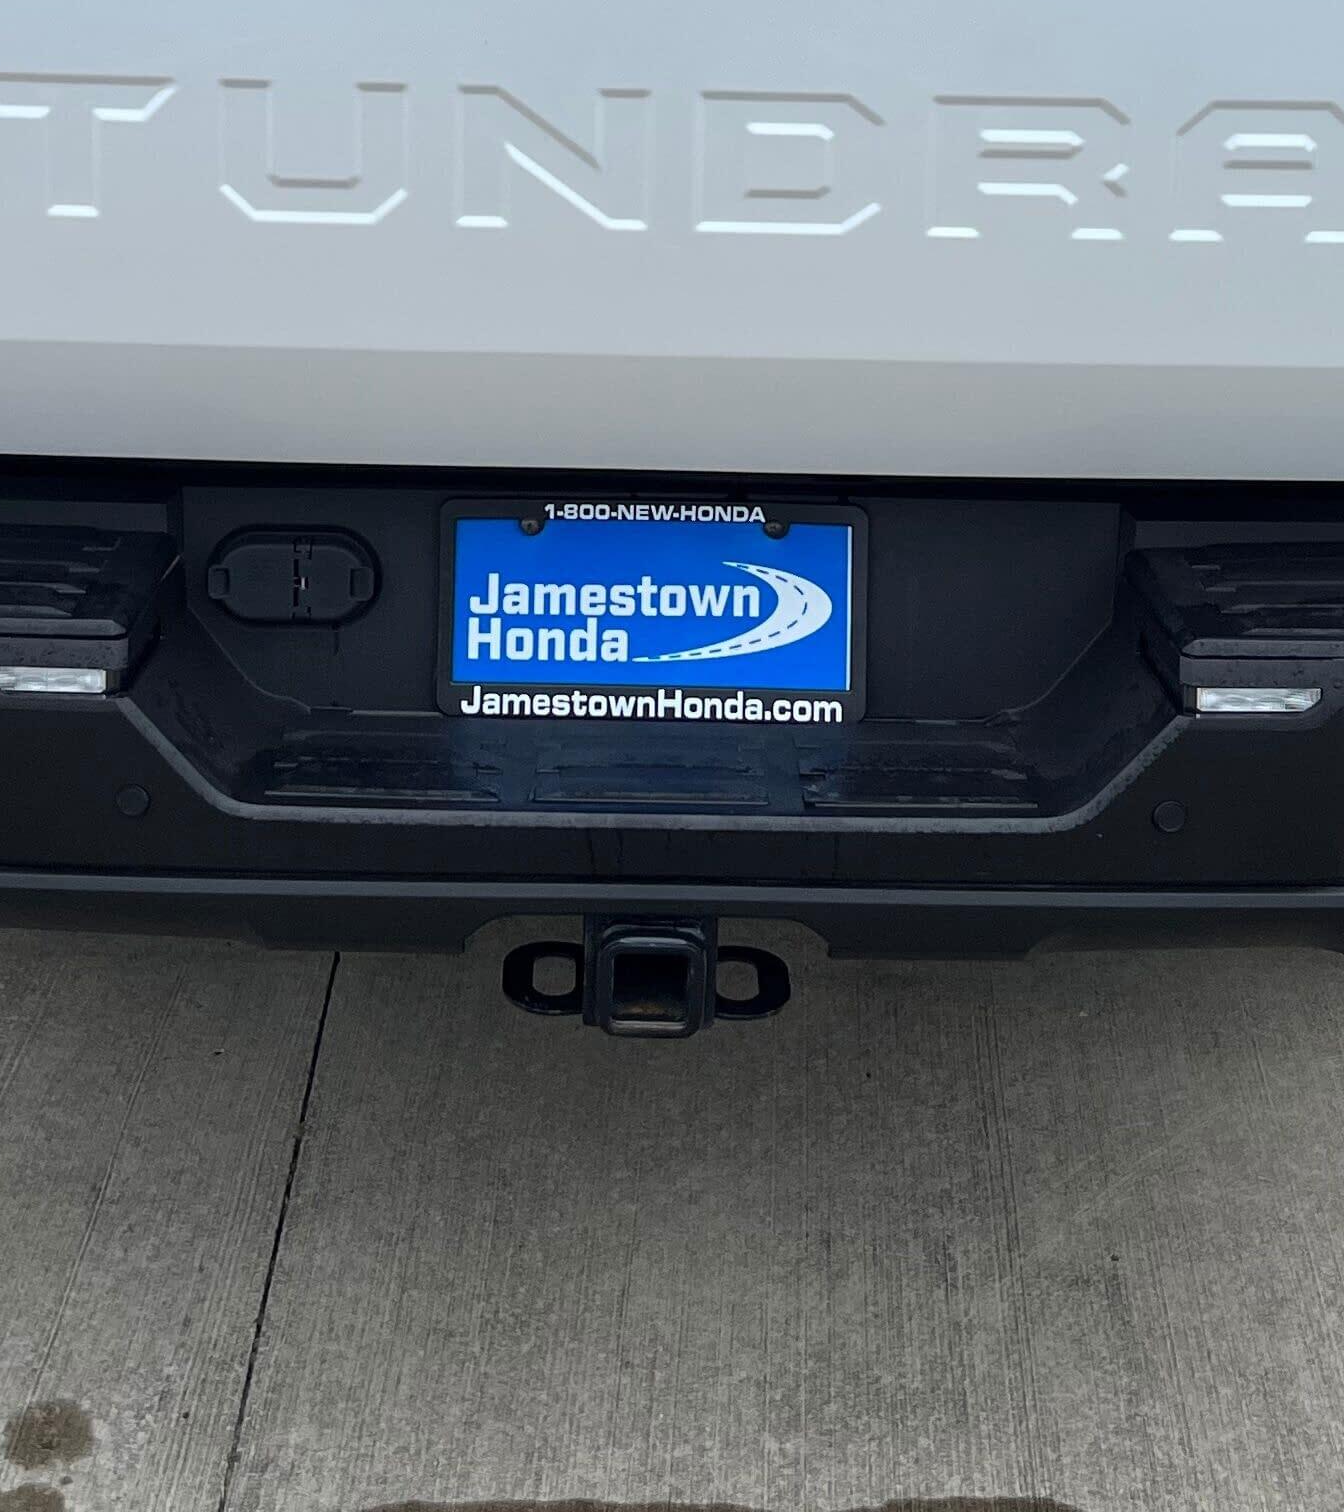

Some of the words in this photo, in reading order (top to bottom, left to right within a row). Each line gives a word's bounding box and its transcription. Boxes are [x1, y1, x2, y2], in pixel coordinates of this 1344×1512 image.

[544, 503, 766, 524] 1-800-NEW-HONDA
[469, 572, 761, 618] Jamestown
[467, 617, 629, 663] Honda
[460, 685, 843, 723] JamestownHonda.com
